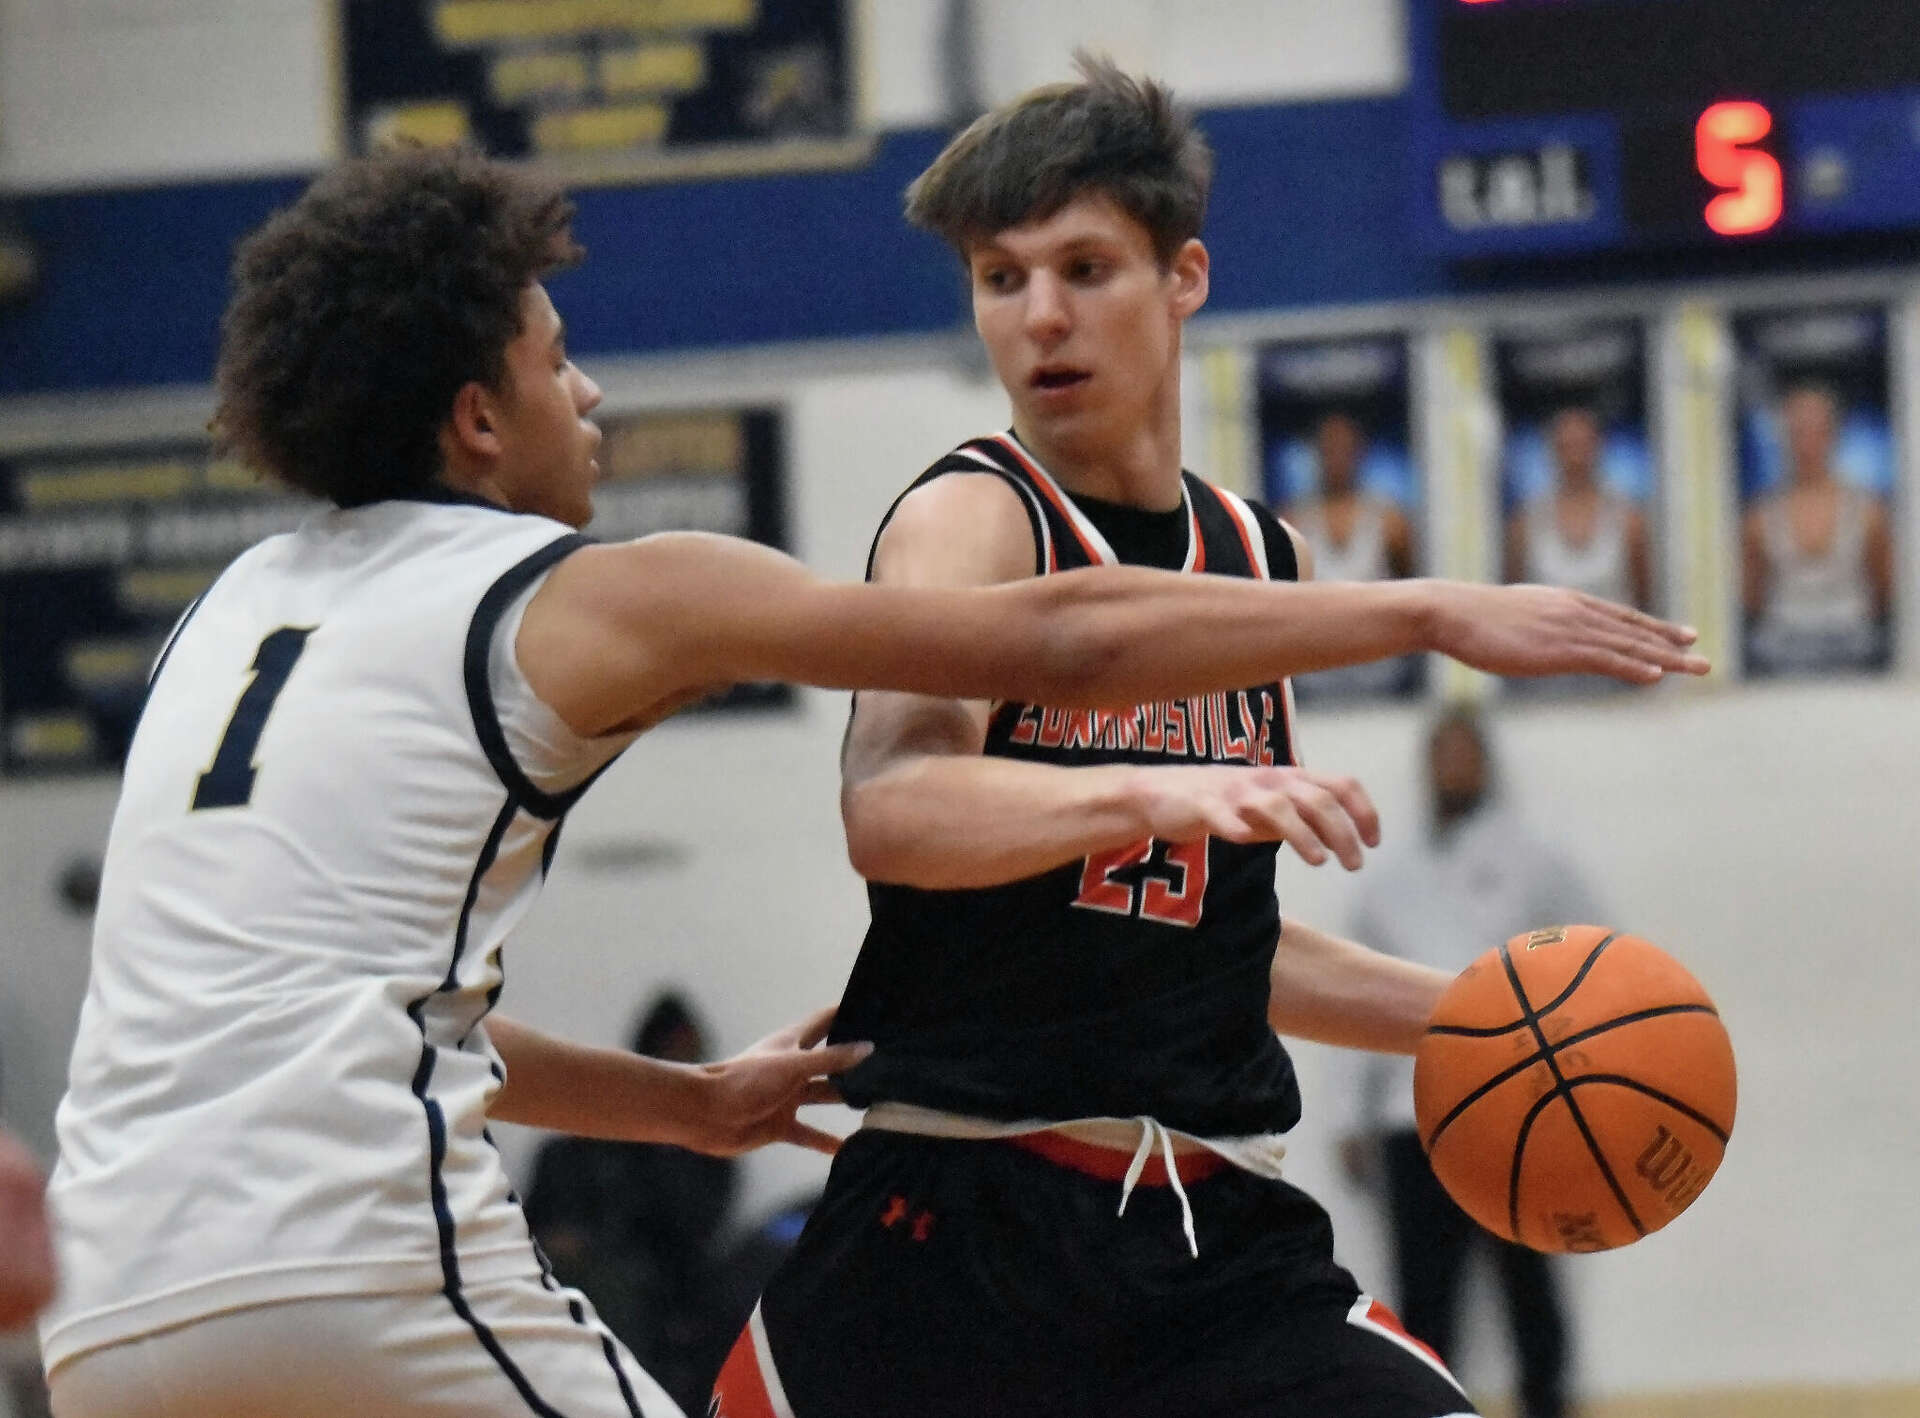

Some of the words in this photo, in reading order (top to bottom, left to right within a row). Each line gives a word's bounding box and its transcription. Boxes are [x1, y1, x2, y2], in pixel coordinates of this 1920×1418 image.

[1695, 100, 1783, 237] 5
[187, 623, 321, 815] 1
[1071, 832, 1210, 928] 23
